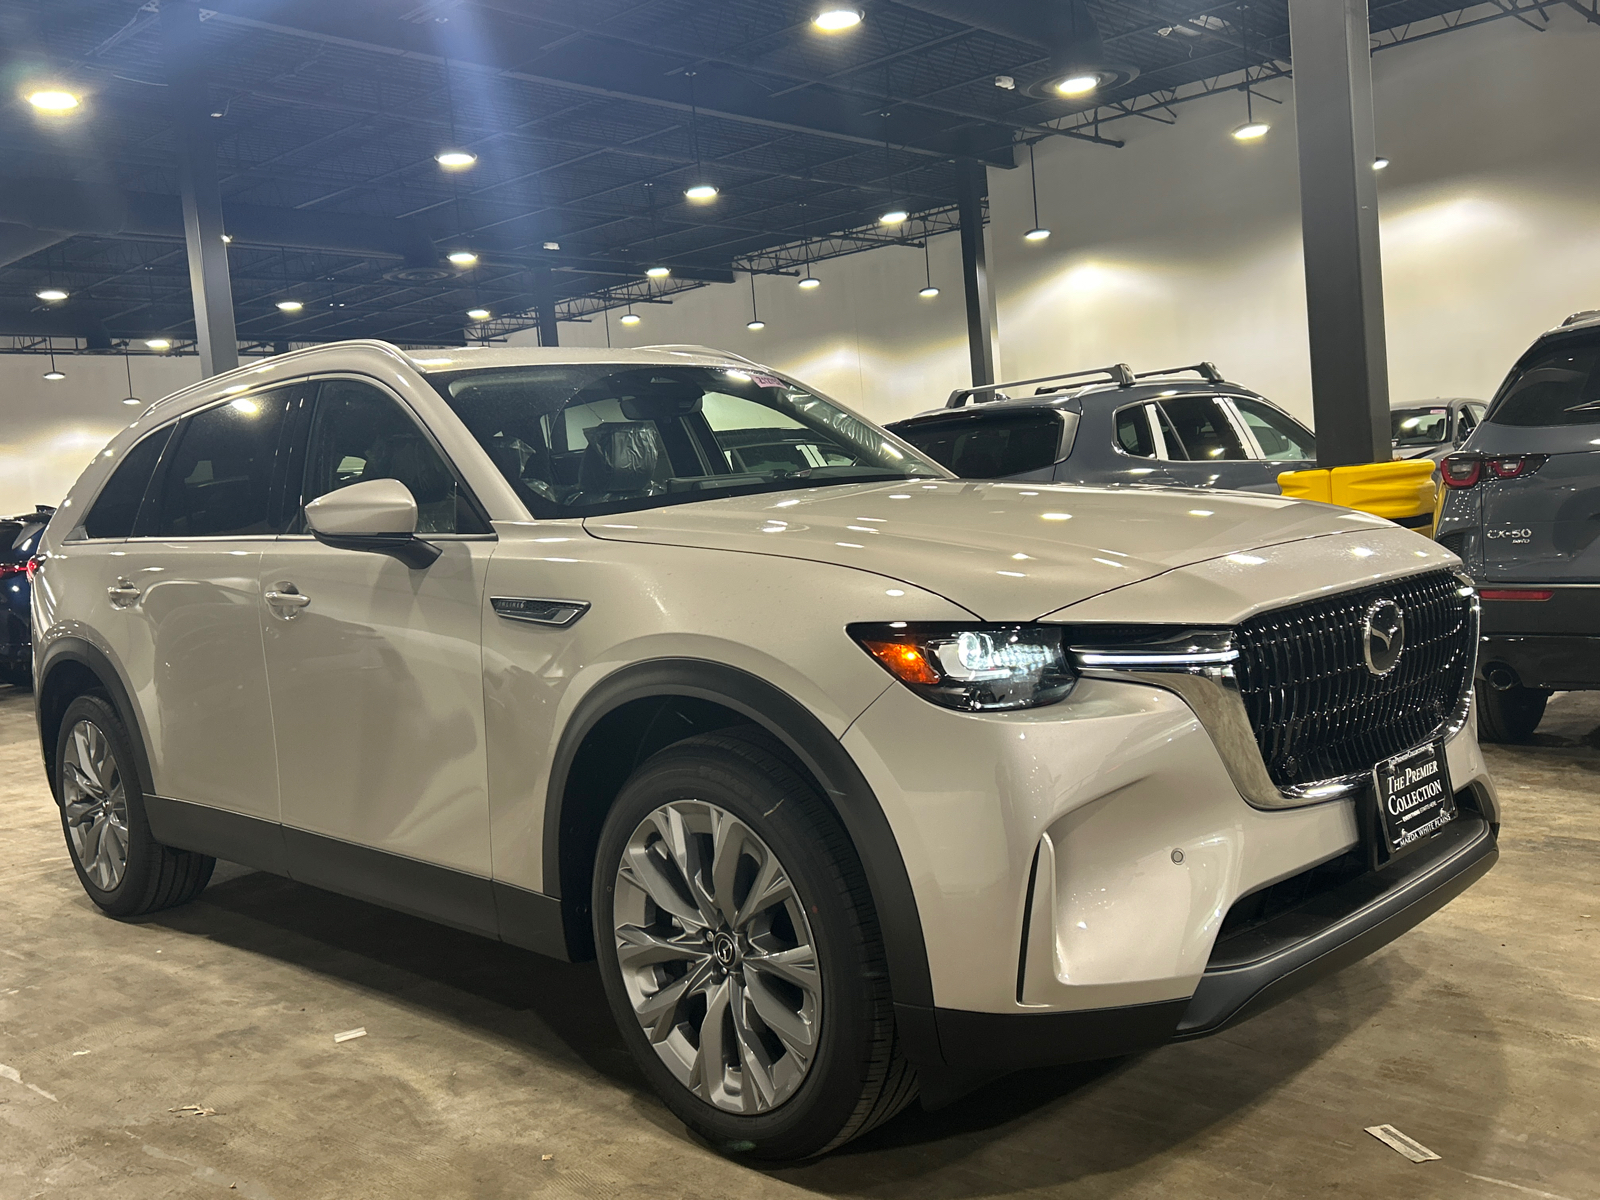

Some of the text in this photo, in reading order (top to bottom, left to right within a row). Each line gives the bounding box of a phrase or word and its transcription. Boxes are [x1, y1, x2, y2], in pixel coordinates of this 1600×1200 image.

[1487, 528, 1532, 539] CX-50
[1387, 760, 1439, 795] THE PREMIER
[1388, 779, 1443, 816] COLLECTION
[1400, 832, 1419, 847] MAZDA
[1418, 823, 1435, 836] WHITE
